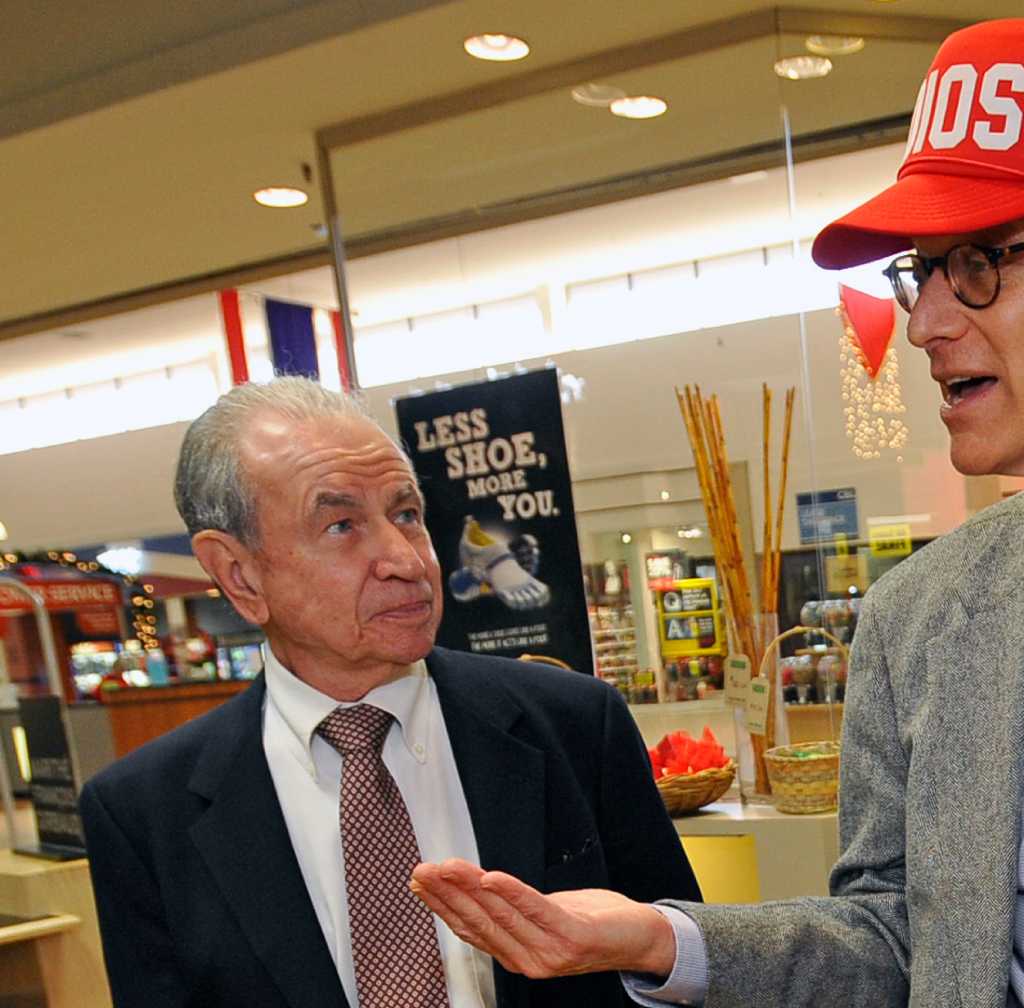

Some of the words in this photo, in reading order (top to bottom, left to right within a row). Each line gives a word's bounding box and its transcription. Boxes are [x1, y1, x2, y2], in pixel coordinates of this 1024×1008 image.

[414, 408, 489, 451] LESS
[445, 431, 547, 480] SHOE,
[466, 469, 528, 499] MORE
[497, 490, 560, 521] YOU.
